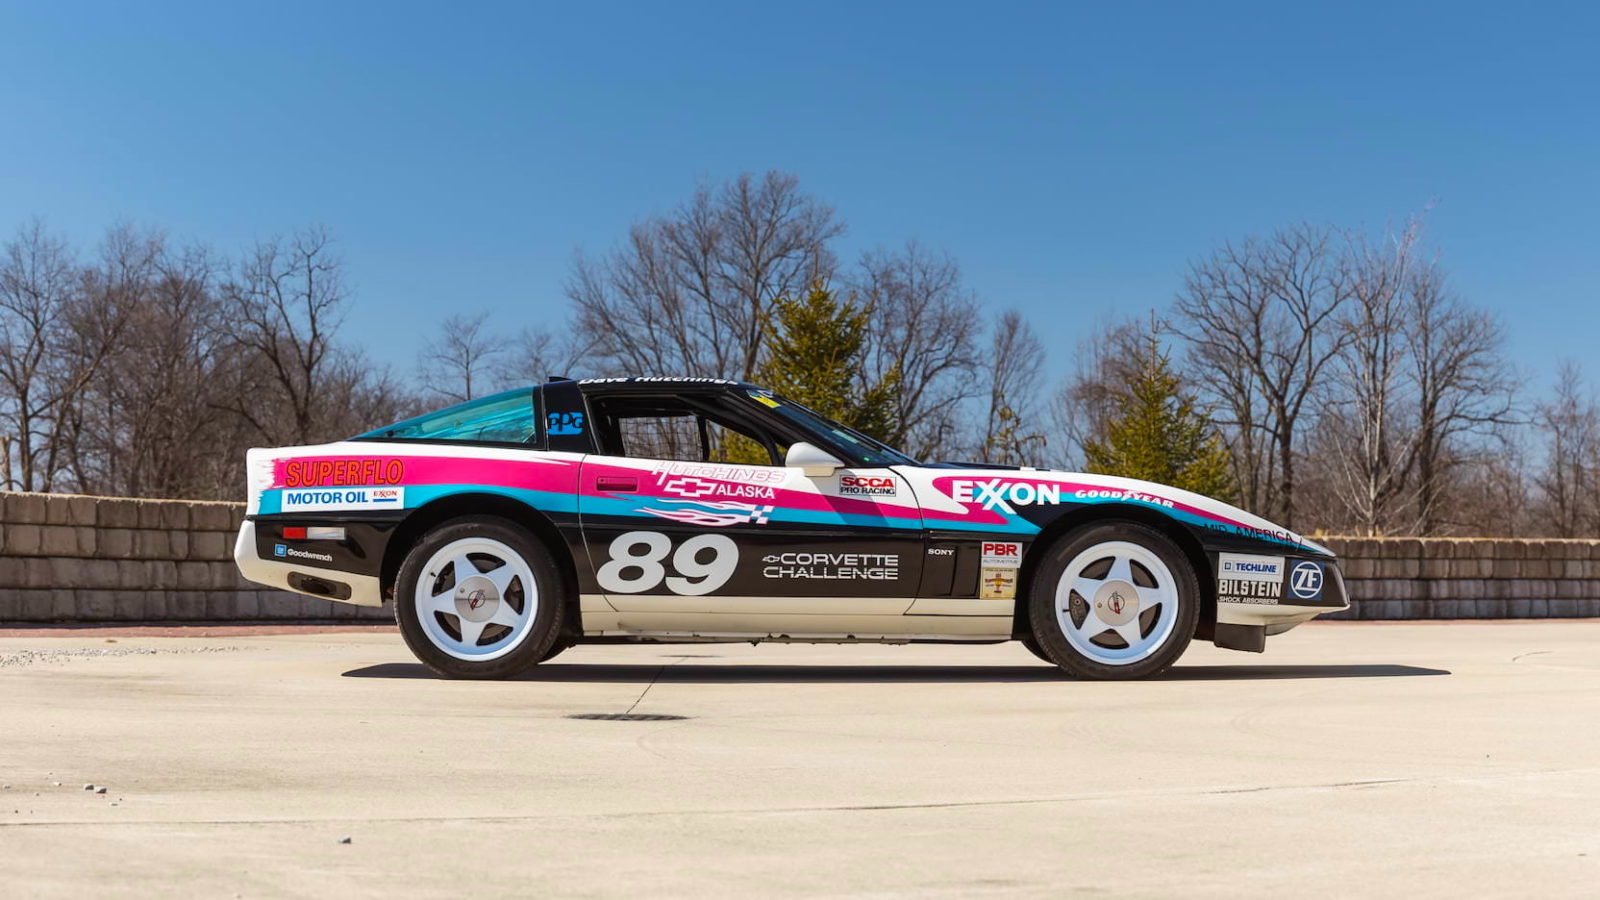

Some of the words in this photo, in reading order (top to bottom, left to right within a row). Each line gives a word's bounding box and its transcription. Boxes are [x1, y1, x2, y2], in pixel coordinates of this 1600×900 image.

[286, 459, 404, 488] SUPERFLO
[841, 476, 895, 488] SCCA
[287, 492, 342, 505] MOTOR
[345, 491, 369, 504] OIL
[373, 490, 398, 498] EXXON
[716, 484, 776, 499] ALASKA
[862, 487, 895, 495] RACING
[952, 478, 1061, 515] EXXON
[1075, 489, 1174, 509] GOODYEAR
[287, 548, 333, 562] Goodwrench
[928, 548, 954, 556] SONY
[983, 543, 1018, 557] PBR
[596, 530, 740, 596] 89
[781, 553, 899, 567] CORVETTE
[763, 566, 899, 580] CHALLENGE
[1236, 562, 1277, 573] TECHLINE
[1294, 568, 1321, 592] ZF
[1218, 579, 1280, 598] BILSTEIN
[1219, 596, 1240, 604] SHOCK
[1242, 597, 1279, 605] ABSORBERS
